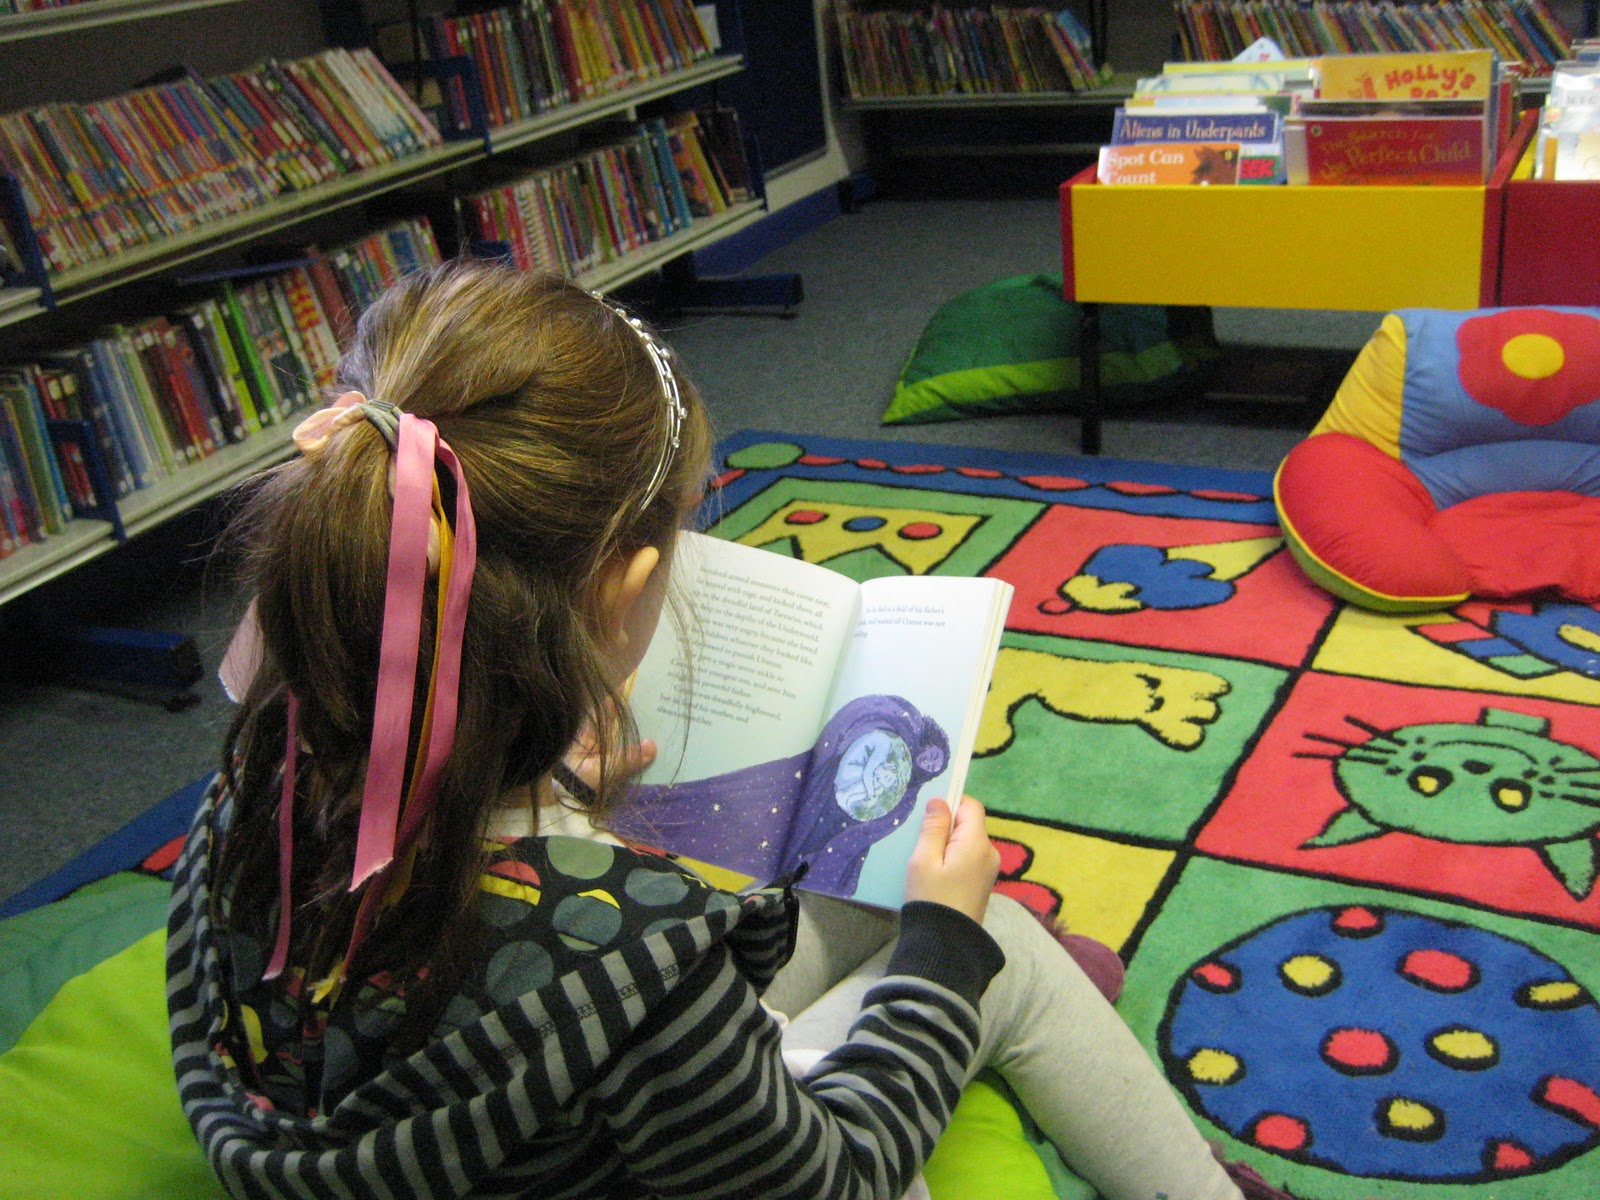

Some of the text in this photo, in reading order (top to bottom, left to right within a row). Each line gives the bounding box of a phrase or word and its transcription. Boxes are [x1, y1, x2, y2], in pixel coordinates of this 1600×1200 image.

[1119, 119, 1266, 143] Aliens in Underpants
[1108, 149, 1184, 168] Spot Can
[1106, 171, 1156, 184] Count
